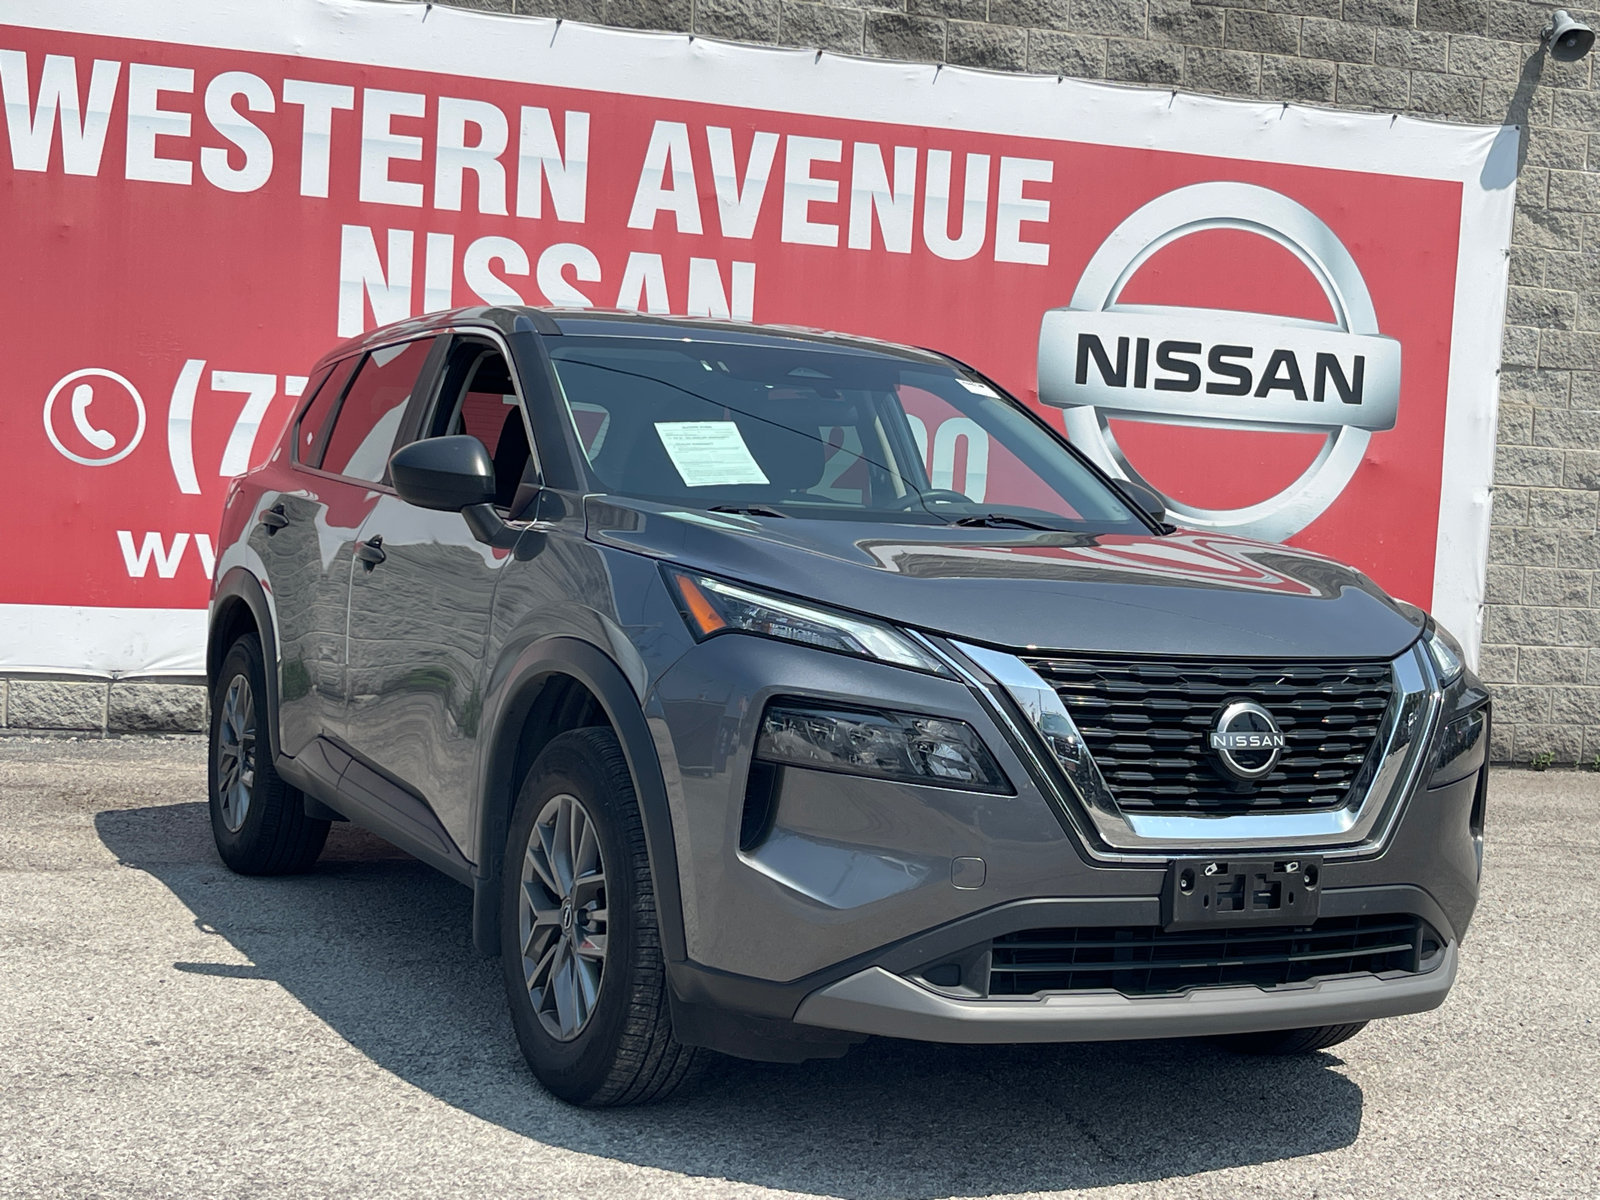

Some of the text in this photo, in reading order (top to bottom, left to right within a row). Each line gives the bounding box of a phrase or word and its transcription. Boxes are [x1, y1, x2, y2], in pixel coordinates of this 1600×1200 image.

[0, 49, 1053, 265] WESTERN AVENUE
[338, 224, 756, 338] NISSAN
[1075, 333, 1365, 405] NISSAN
[168, 359, 309, 494] (7
[1213, 735, 1284, 747] NISSAN
